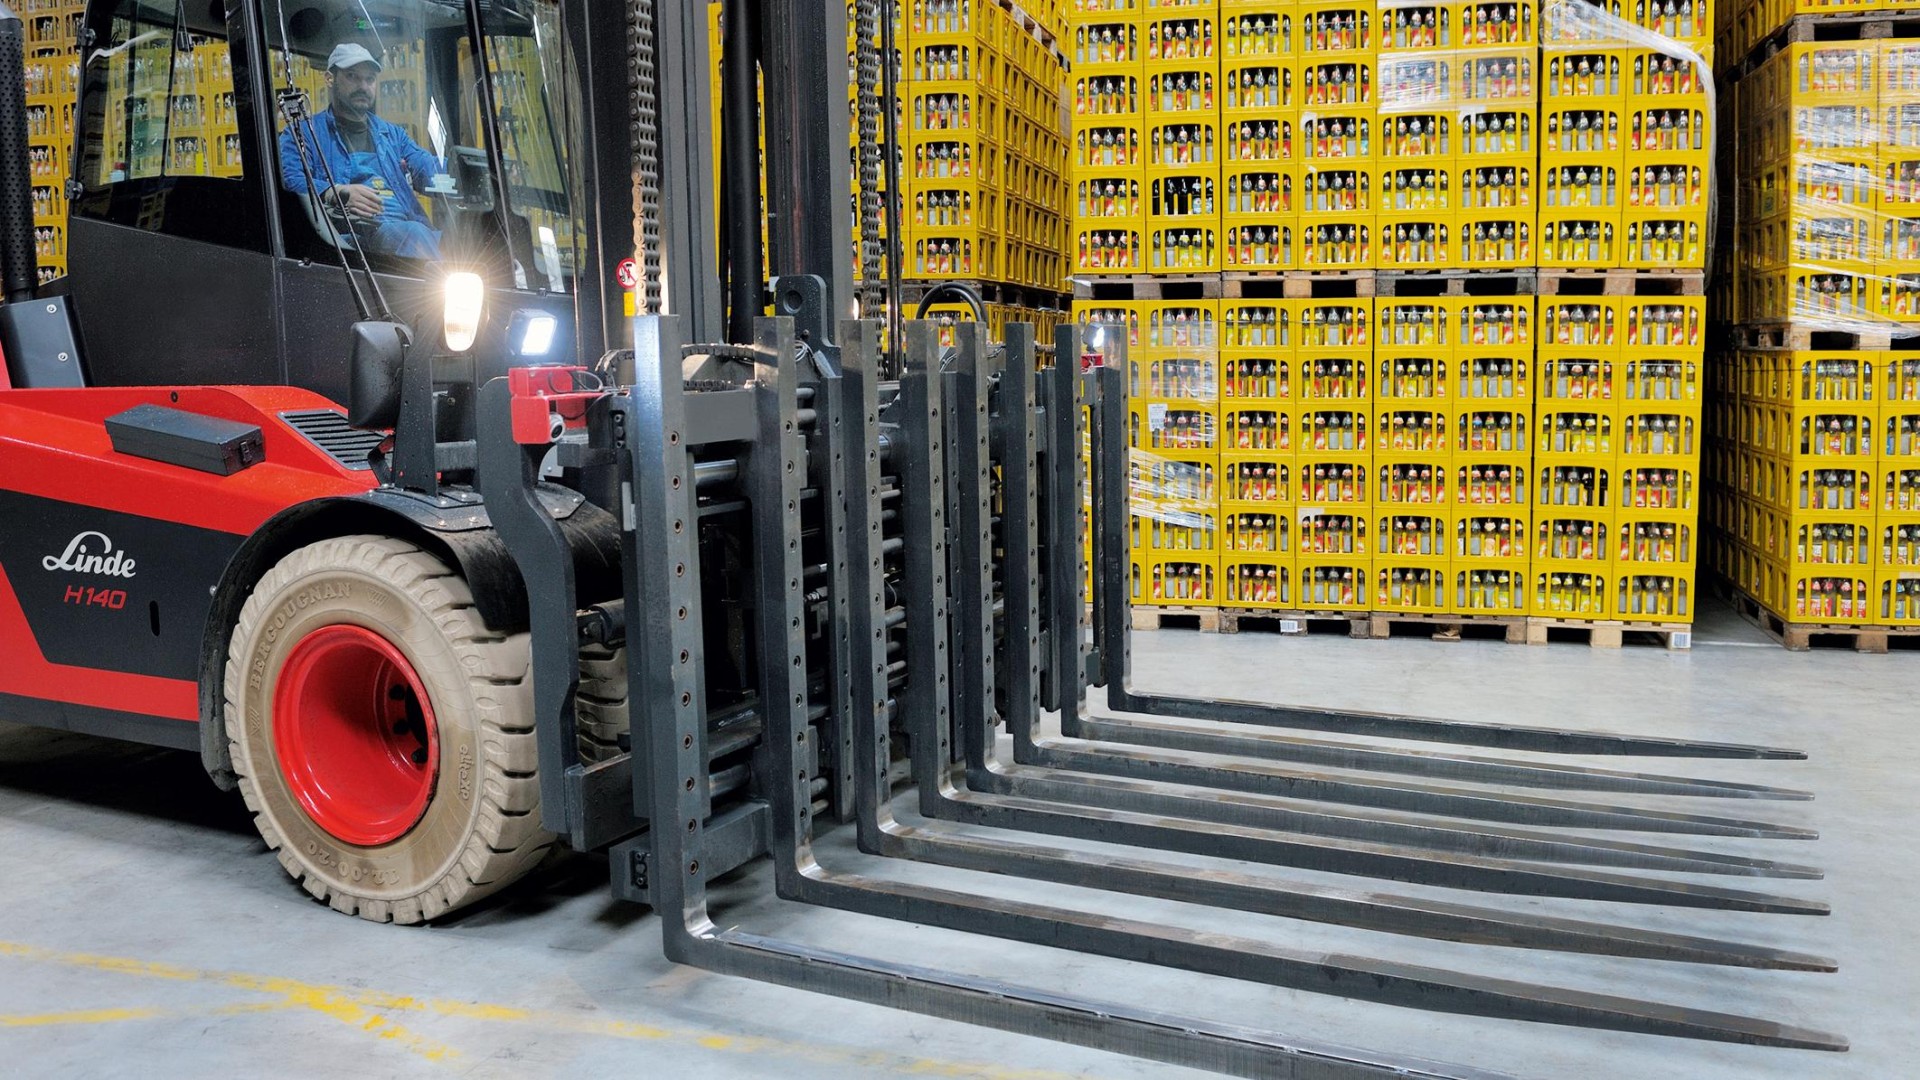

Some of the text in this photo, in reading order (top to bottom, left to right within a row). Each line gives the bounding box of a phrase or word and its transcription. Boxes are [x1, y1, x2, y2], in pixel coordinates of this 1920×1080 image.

[42, 531, 136, 578] Linde
[64, 585, 127, 609] H140
[250, 582, 352, 690] BERGOUGNAN
